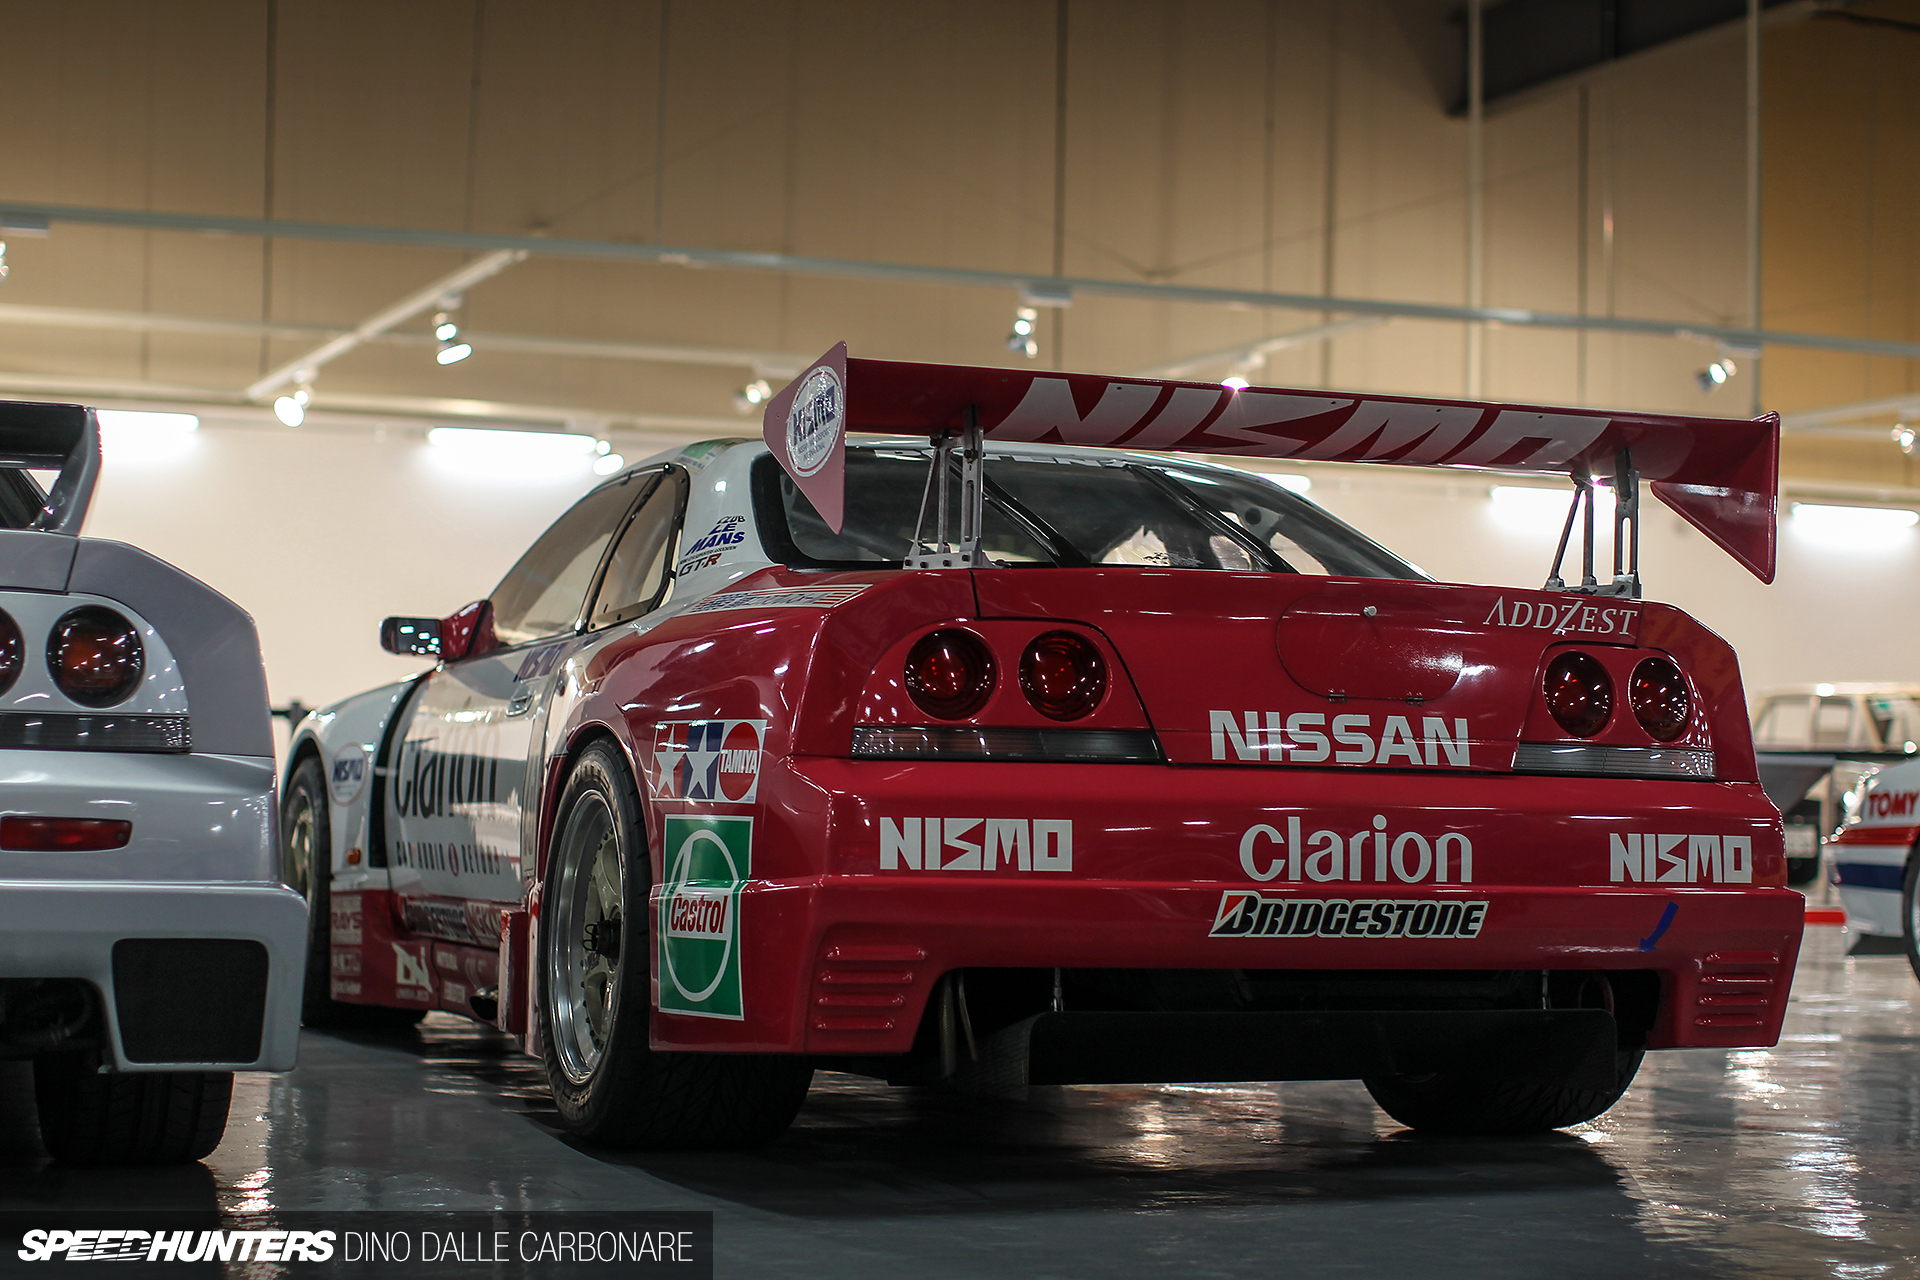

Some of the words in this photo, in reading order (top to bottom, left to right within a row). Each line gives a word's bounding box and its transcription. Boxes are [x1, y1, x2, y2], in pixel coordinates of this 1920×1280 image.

[985, 376, 1611, 470] NISMO
[684, 531, 745, 556] MANS
[707, 522, 738, 535] LE
[1483, 596, 1638, 635] ADDZEST
[720, 749, 758, 774] TAMIYA
[1209, 710, 1470, 766] NISSAN
[879, 817, 1072, 871] NISMO
[1239, 814, 1473, 883] Clarion
[1609, 833, 1752, 883] NISMO
[671, 893, 728, 933] Castrol
[1209, 890, 1488, 938] BRIDGESTONE
